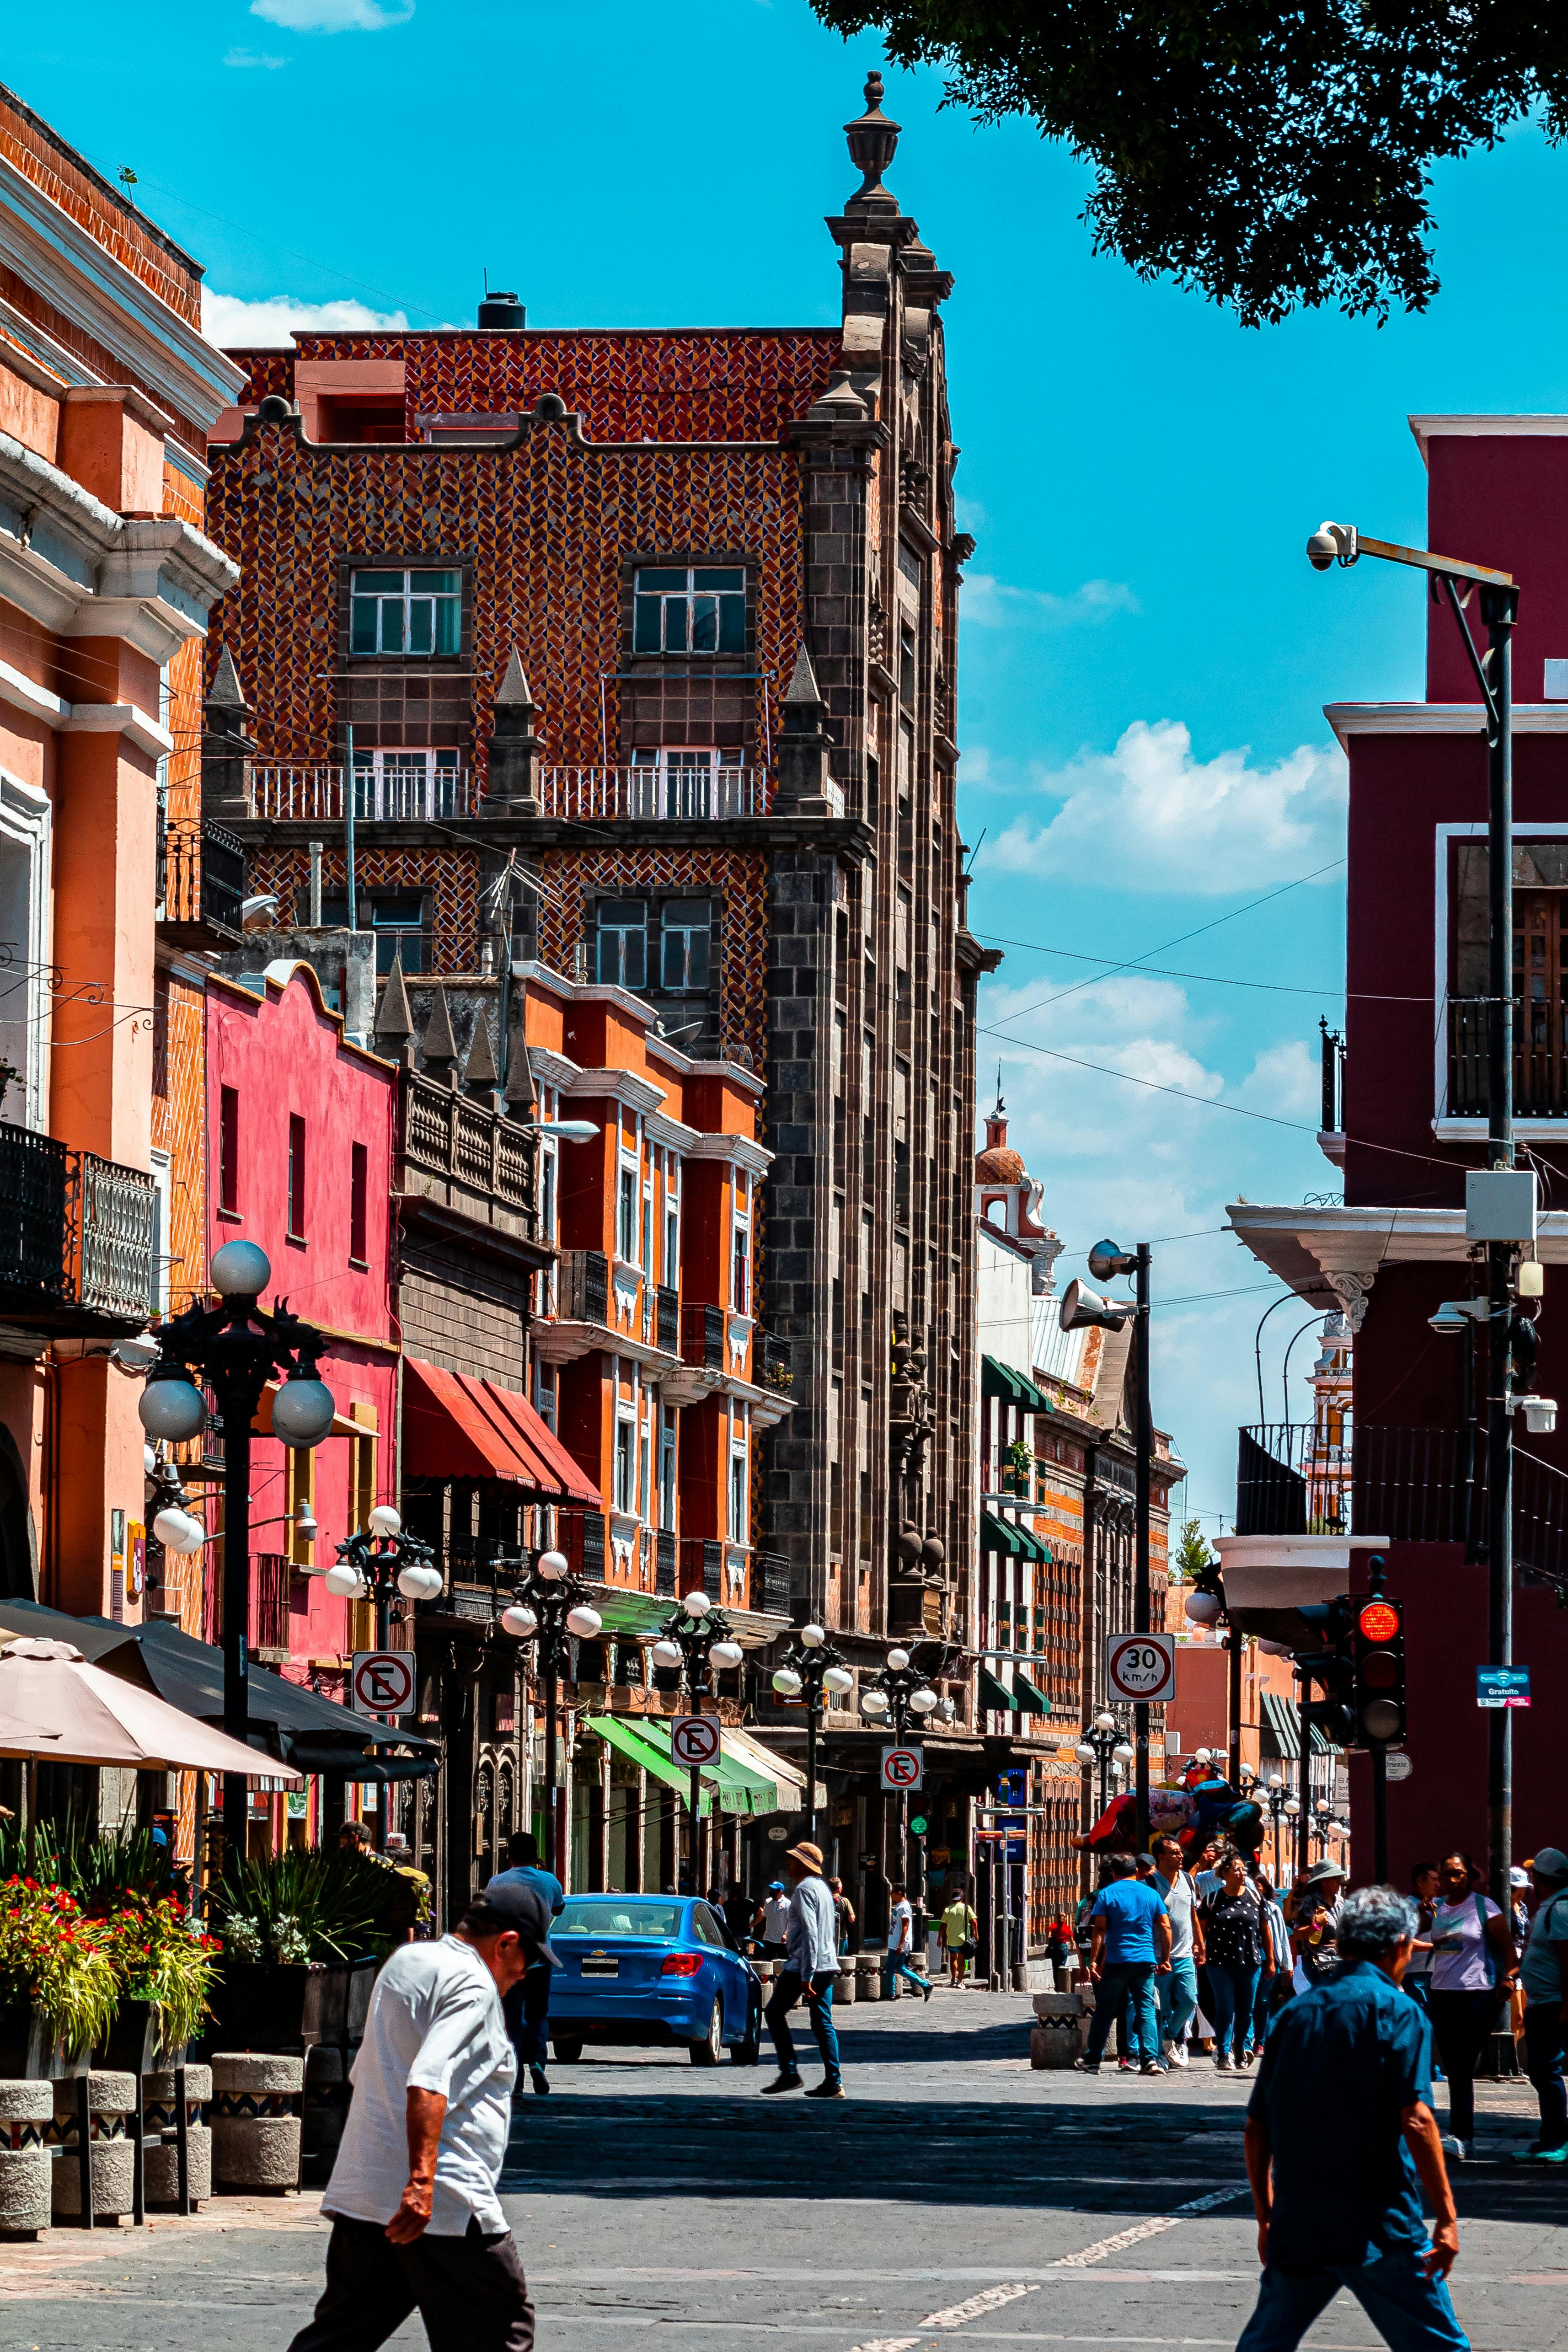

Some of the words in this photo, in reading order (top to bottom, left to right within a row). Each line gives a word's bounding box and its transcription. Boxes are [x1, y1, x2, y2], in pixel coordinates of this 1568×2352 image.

[1126, 1648, 1156, 1669] 30
[371, 1667, 394, 1700] E
[1122, 1671, 1158, 1682] km/h
[686, 1728, 705, 1754] E
[894, 1757, 910, 1780] E
